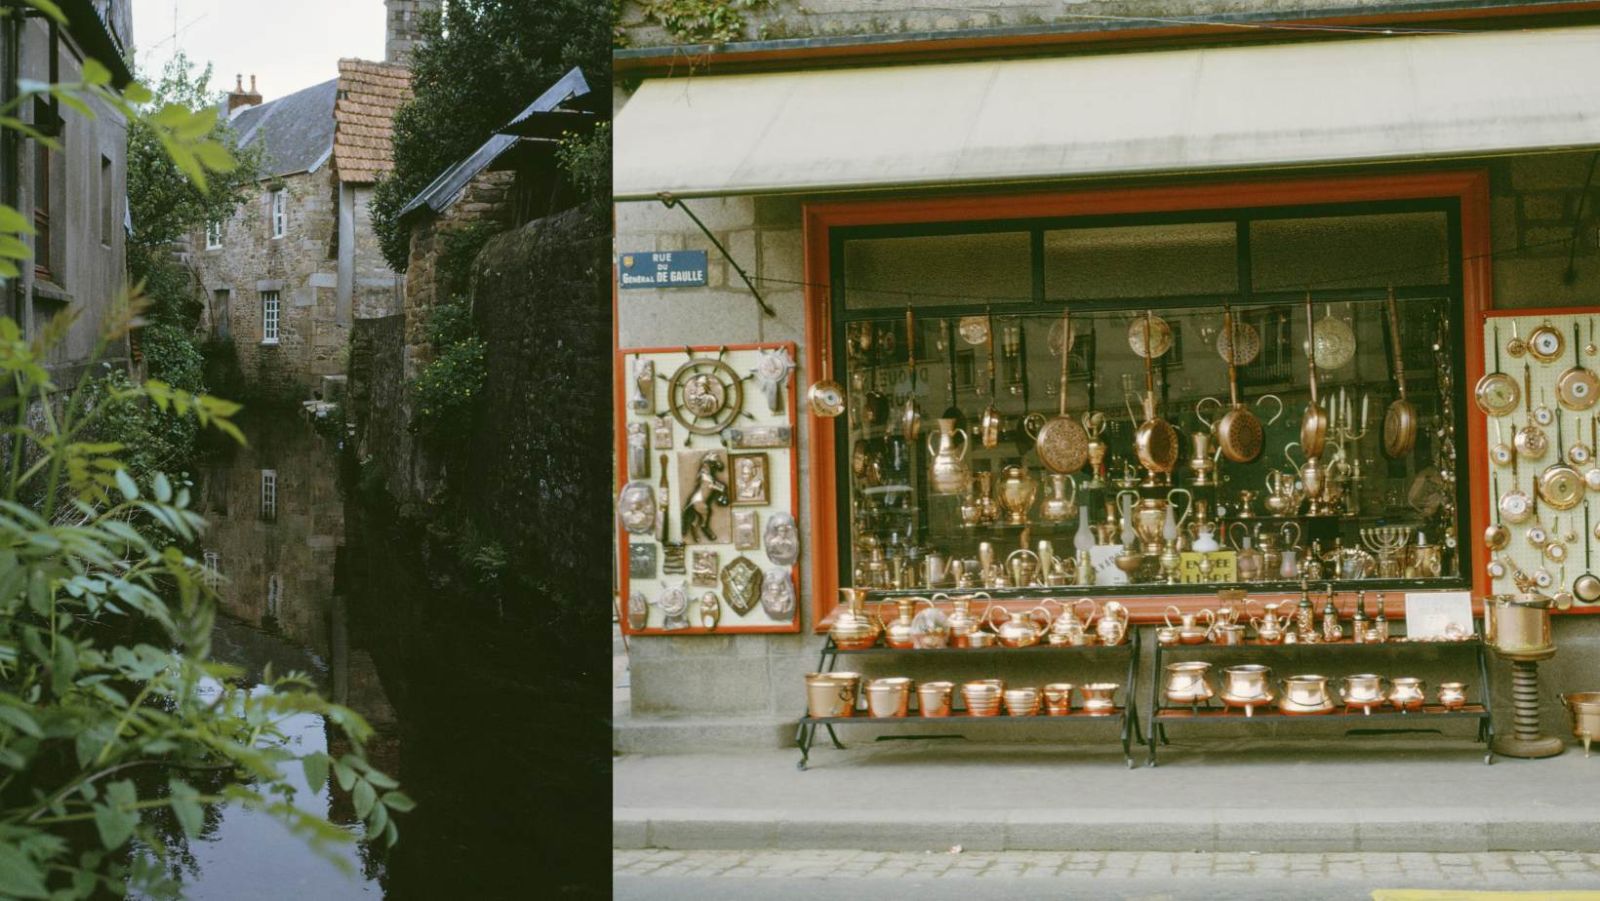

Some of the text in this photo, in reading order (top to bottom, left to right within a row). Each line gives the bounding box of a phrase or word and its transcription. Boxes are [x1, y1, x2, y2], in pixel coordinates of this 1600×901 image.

[652, 253, 672, 262] RUE
[657, 263, 668, 271] DU
[656, 271, 668, 282] DE
[670, 270, 703, 282] GAULLE
